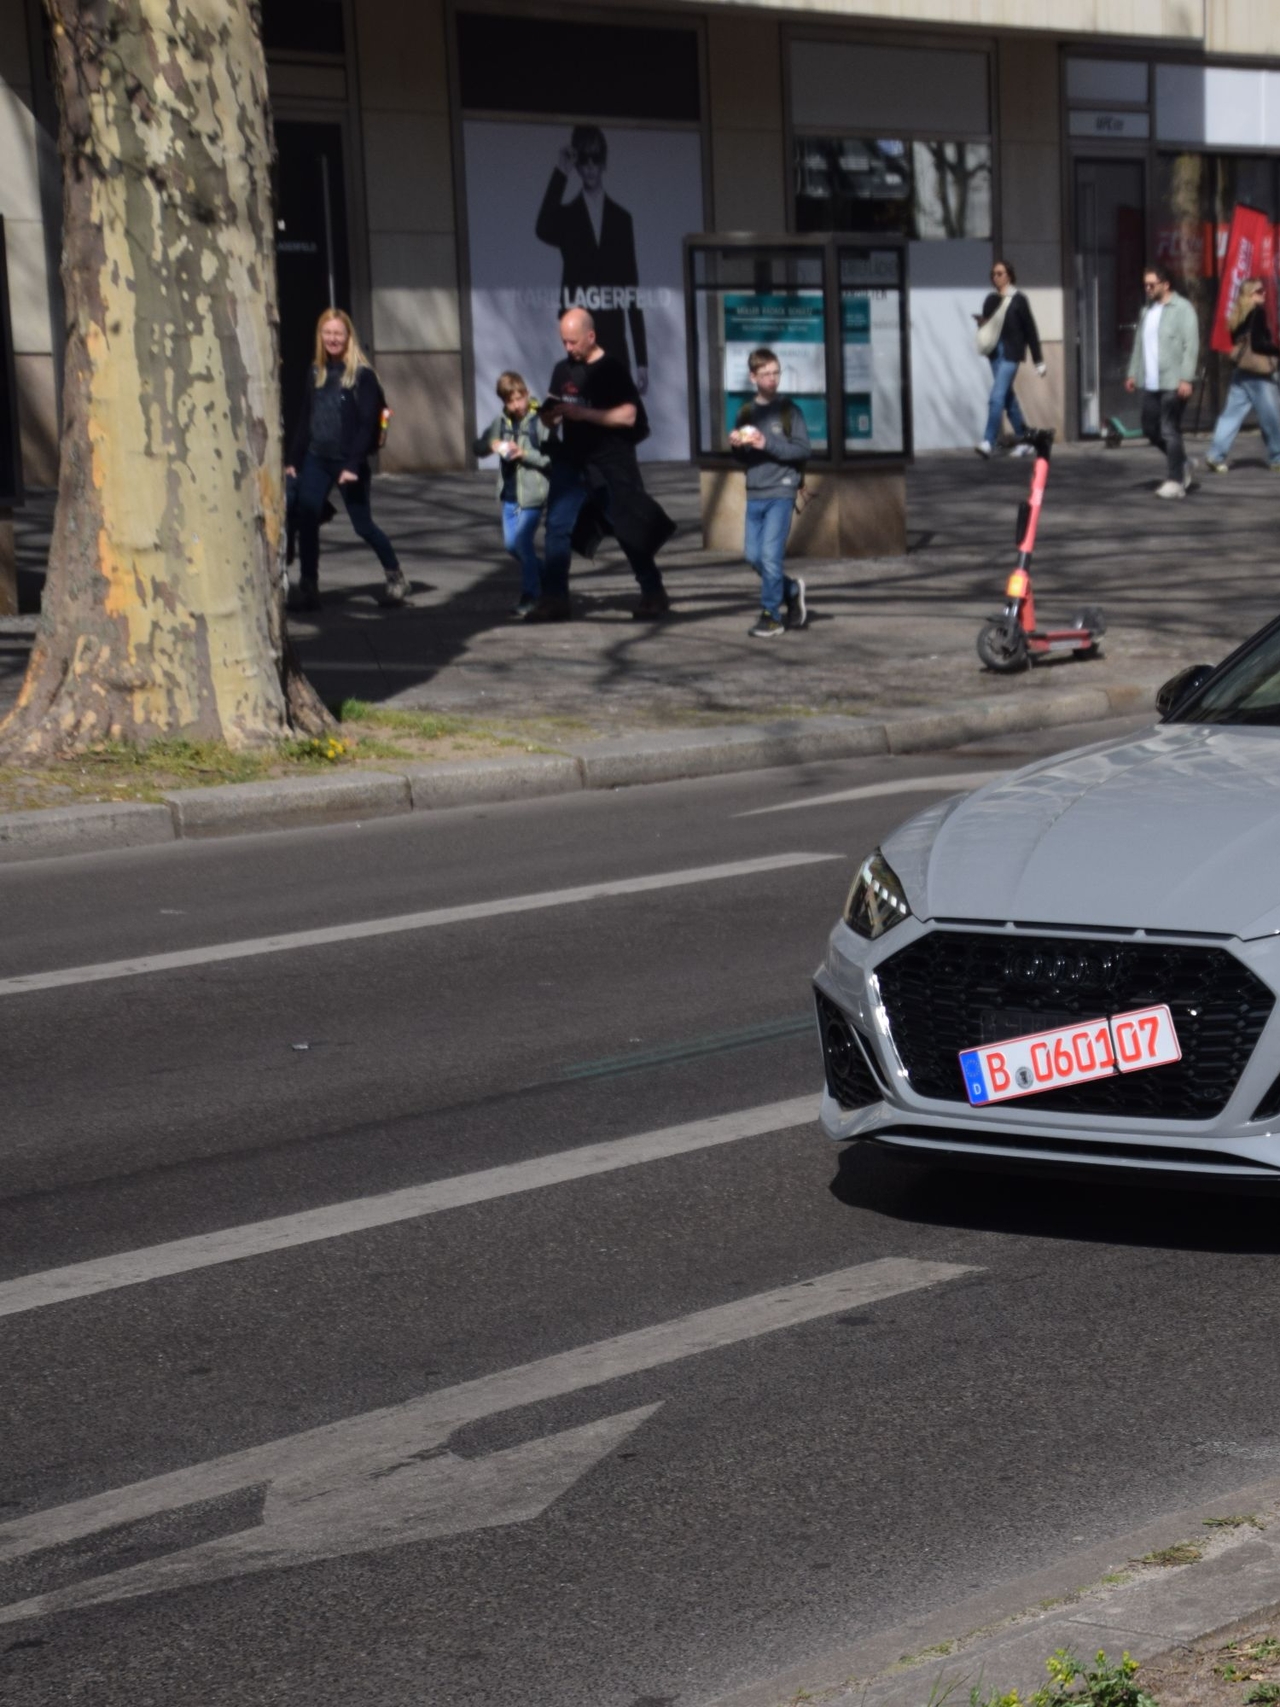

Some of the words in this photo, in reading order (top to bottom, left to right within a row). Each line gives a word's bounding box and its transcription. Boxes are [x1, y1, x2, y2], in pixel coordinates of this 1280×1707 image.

[562, 285, 672, 310] LAGERFELD
[985, 1051, 1011, 1093] B
[1030, 1015, 1160, 1083] 060107
[972, 1083, 982, 1096] D
